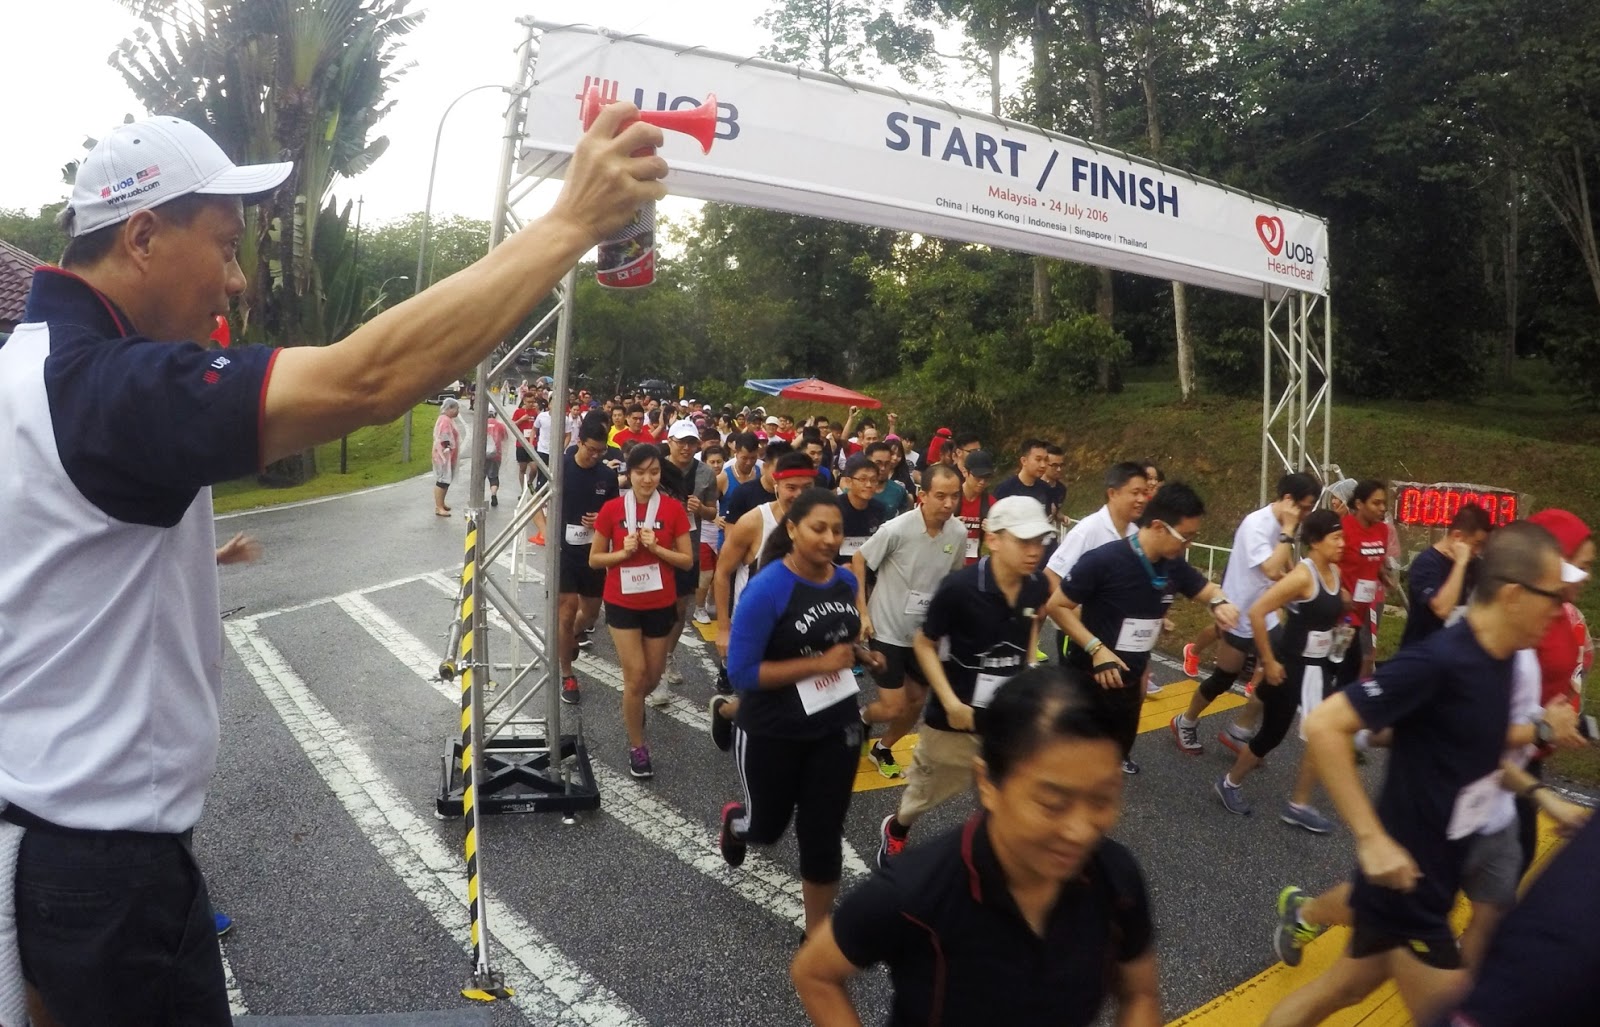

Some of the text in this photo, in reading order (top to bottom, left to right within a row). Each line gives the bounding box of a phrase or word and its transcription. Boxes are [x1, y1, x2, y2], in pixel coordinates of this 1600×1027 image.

[885, 111, 1027, 178] START
[1071, 156, 1179, 217] FINISH
[112, 177, 134, 193] UOB
[988, 185, 1108, 223] Malaysia 24 July 2016
[935, 197, 1148, 249] China Hong Kong Indonesia Singapore Thailand
[1285, 240, 1314, 264] UOB
[1267, 257, 1314, 281] Heartbeat
